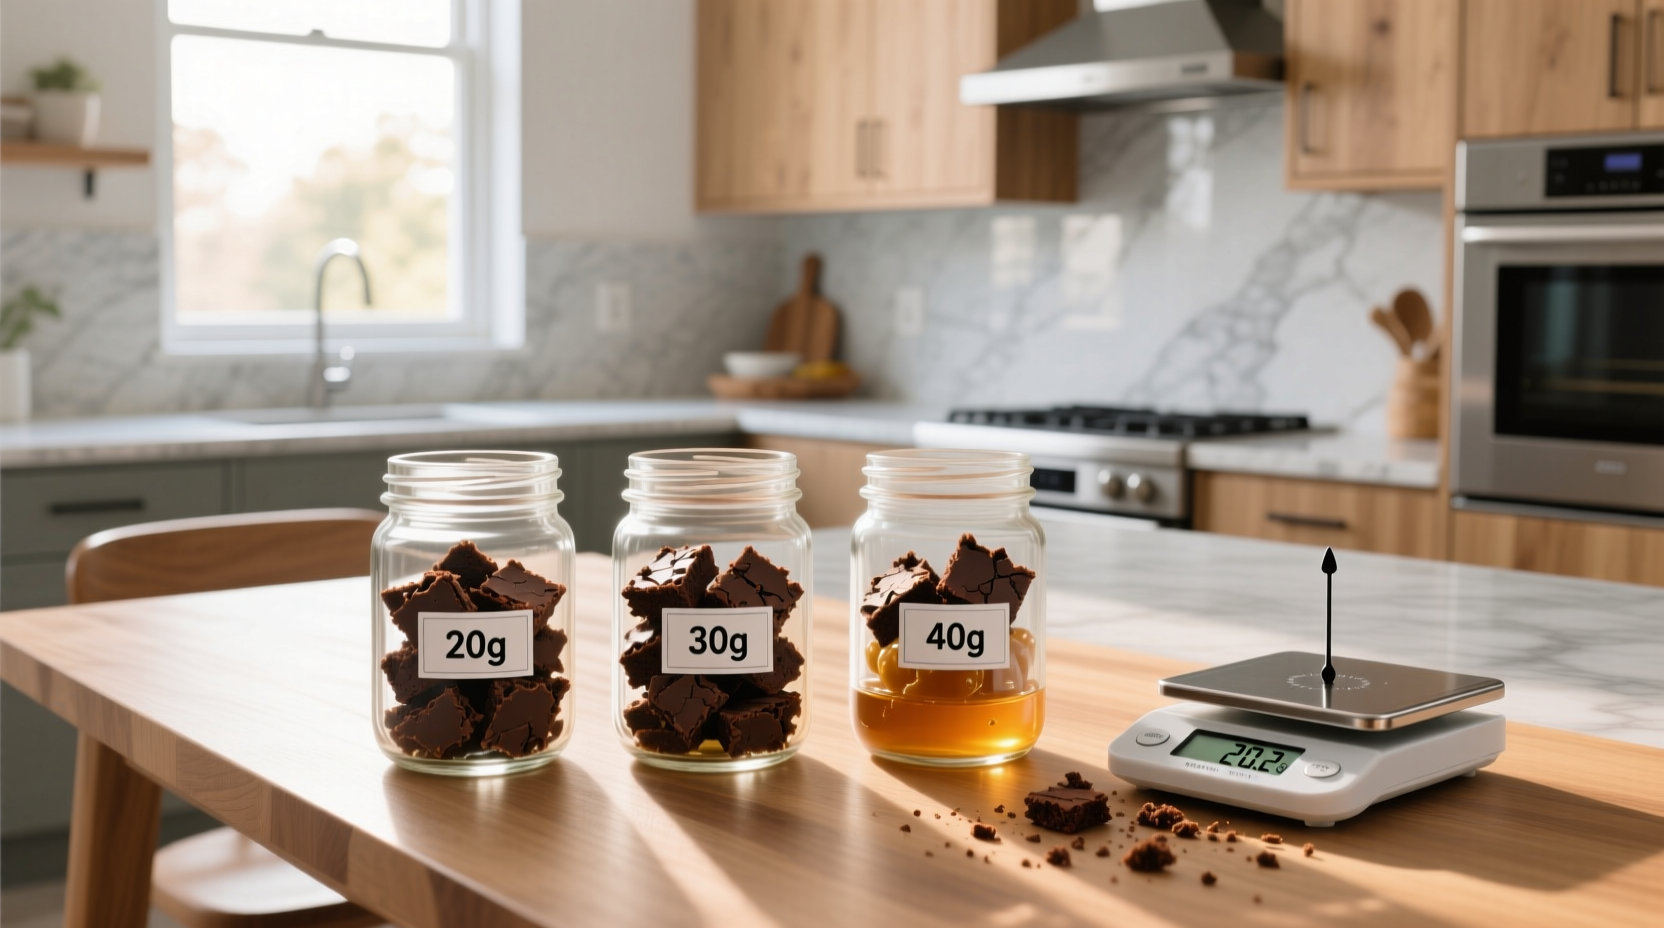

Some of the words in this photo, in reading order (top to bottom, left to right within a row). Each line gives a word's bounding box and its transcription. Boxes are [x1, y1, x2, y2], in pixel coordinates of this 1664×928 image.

[445, 629, 506, 667] 20g
[688, 625, 748, 662] 30g
[925, 622, 985, 659] 40g
